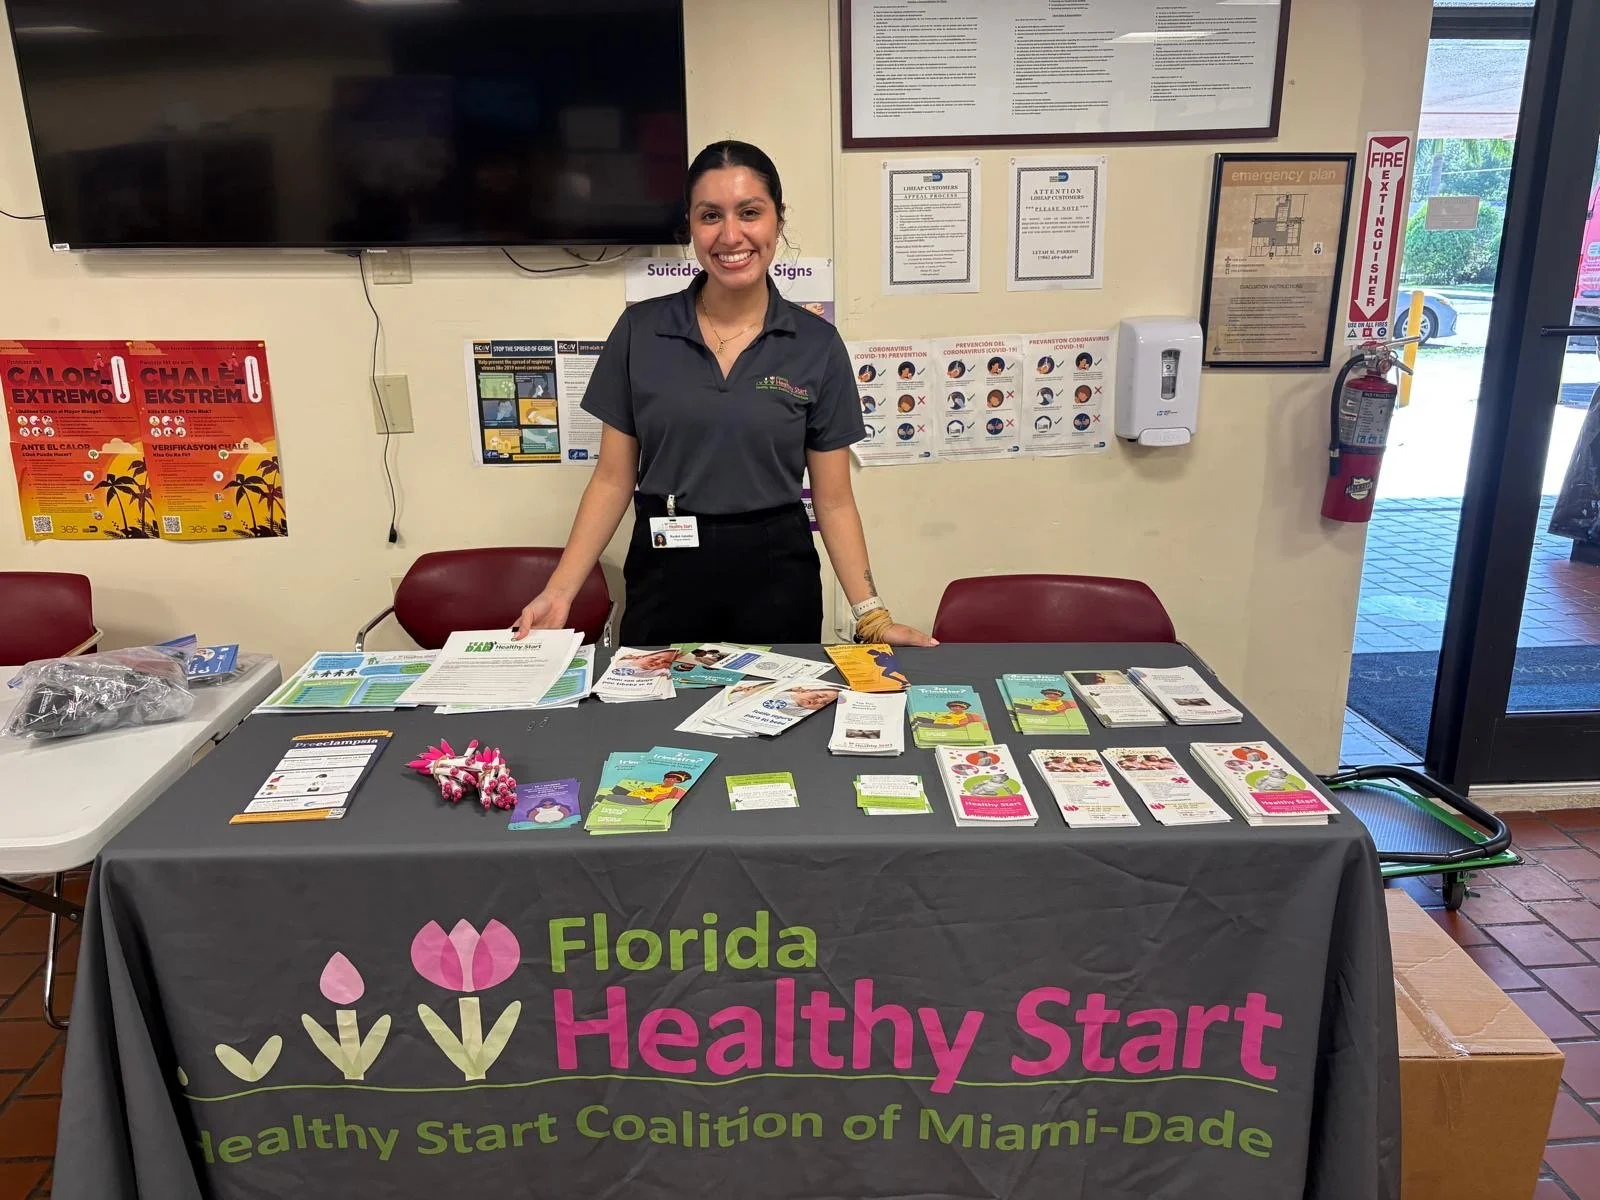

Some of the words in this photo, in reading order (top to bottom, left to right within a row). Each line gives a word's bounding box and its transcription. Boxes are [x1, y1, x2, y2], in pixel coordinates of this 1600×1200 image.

[1371, 152, 1404, 168] FIRE
[1231, 168, 1304, 182] emergency
[1309, 168, 1336, 181] plan
[1366, 170, 1390, 307] EXTINGUISHER
[647, 264, 700, 277] Suicide
[774, 264, 813, 280] Signs
[869, 345, 913, 353] CORONAVIRUS
[943, 347, 986, 356] CORONAVIRUS
[986, 346, 1018, 354] (COVID-19)
[1053, 343, 1085, 351] (COVID-19)
[854, 353, 887, 361] (COVID-19)
[888, 351, 928, 359] PREVENTION
[7, 367, 101, 386] CALOR
[12, 388, 114, 404] EXTREMO
[143, 385, 243, 404] EKSTRÈM
[60, 443, 91, 451] CALOR
[152, 443, 217, 451] VERIFIKASYON
[60, 525, 79, 534] 305
[188, 525, 208, 534] 305
[295, 739, 379, 748] Preeclampsia
[548, 910, 818, 974] Florida
[552, 977, 985, 1094] Healthy
[1010, 986, 1283, 1081] Start
[416, 1111, 558, 1155] Start
[575, 1104, 822, 1149] Coalition
[843, 1103, 902, 1141] of
[919, 1106, 1273, 1159] Miami-Dade
